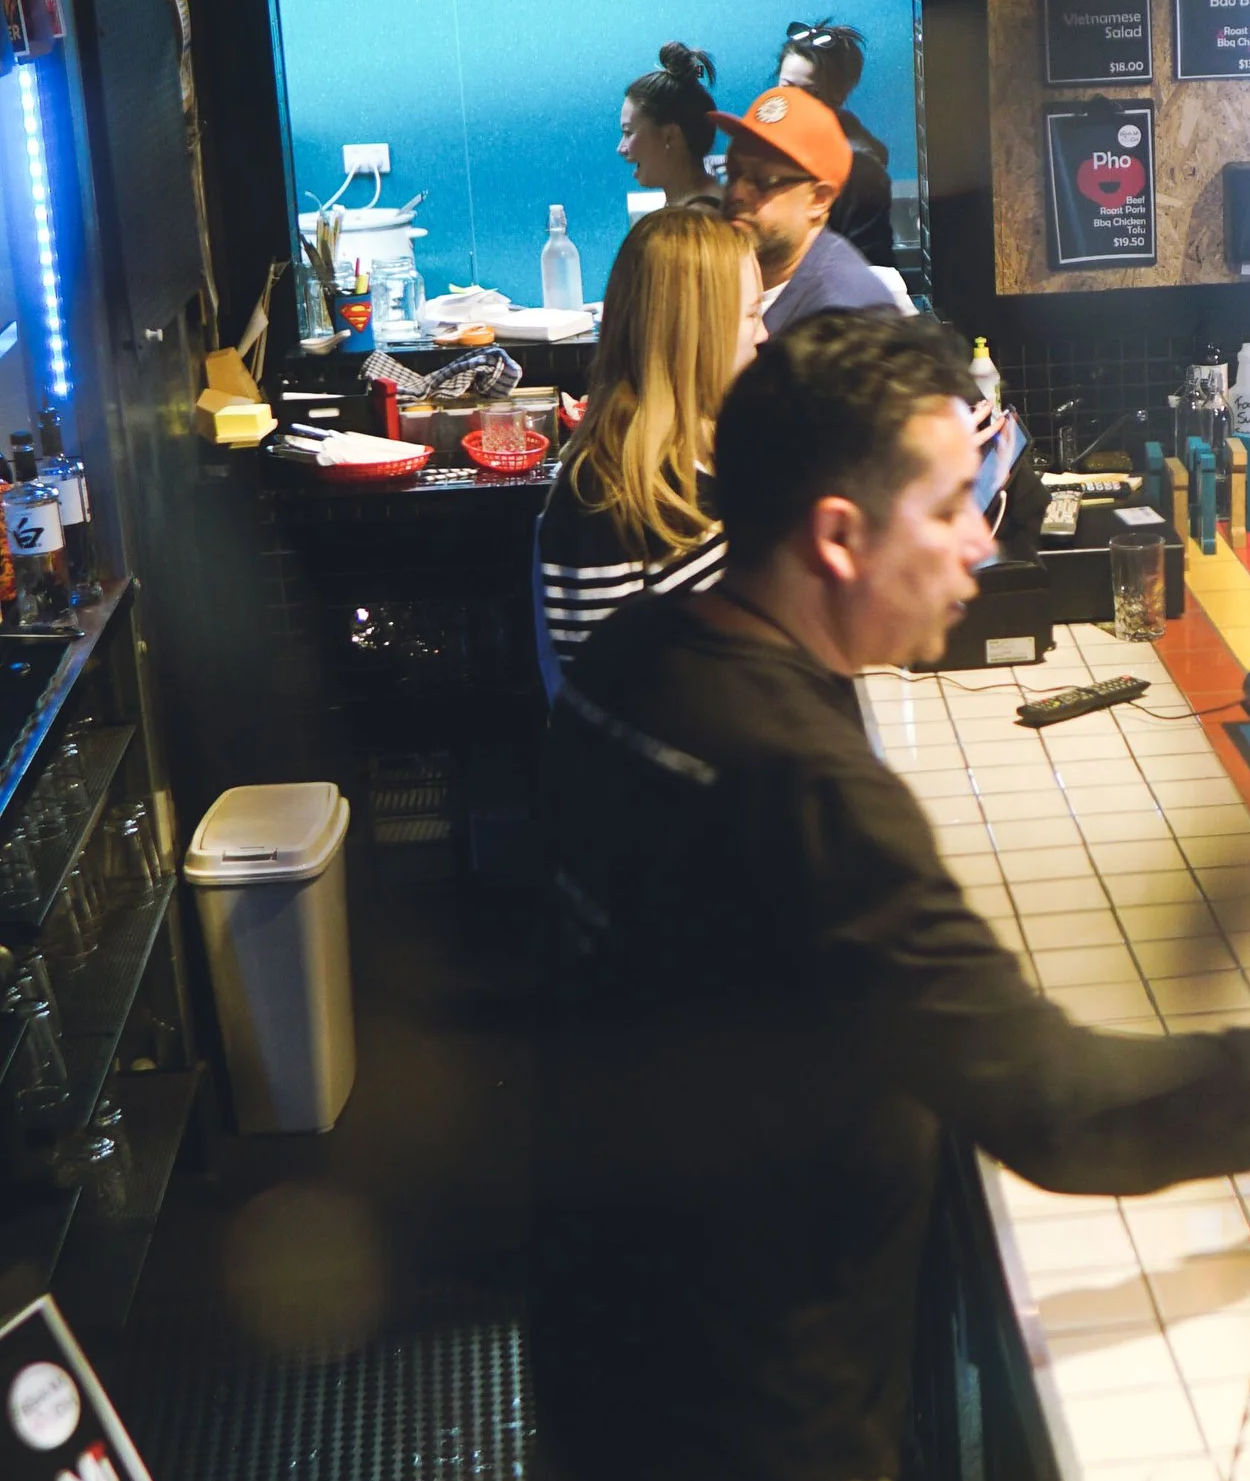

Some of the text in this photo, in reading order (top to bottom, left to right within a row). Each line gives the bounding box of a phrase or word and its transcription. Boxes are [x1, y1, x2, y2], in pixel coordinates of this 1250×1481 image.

[1064, 12, 1142, 26] Vietnamese
[1105, 25, 1142, 39] Salad
[1223, 26, 1248, 36] Roast
[1217, 38, 1236, 48] Bbq
[1109, 61, 1144, 73] $18.00
[1093, 151, 1132, 170] Pho
[1126, 196, 1145, 205] Beef
[1100, 205, 1146, 215] Roast Pork
[1093, 217, 1146, 228] Bbq Chicken
[1127, 226, 1146, 235] Tofu
[1113, 238, 1145, 248] $19.50
